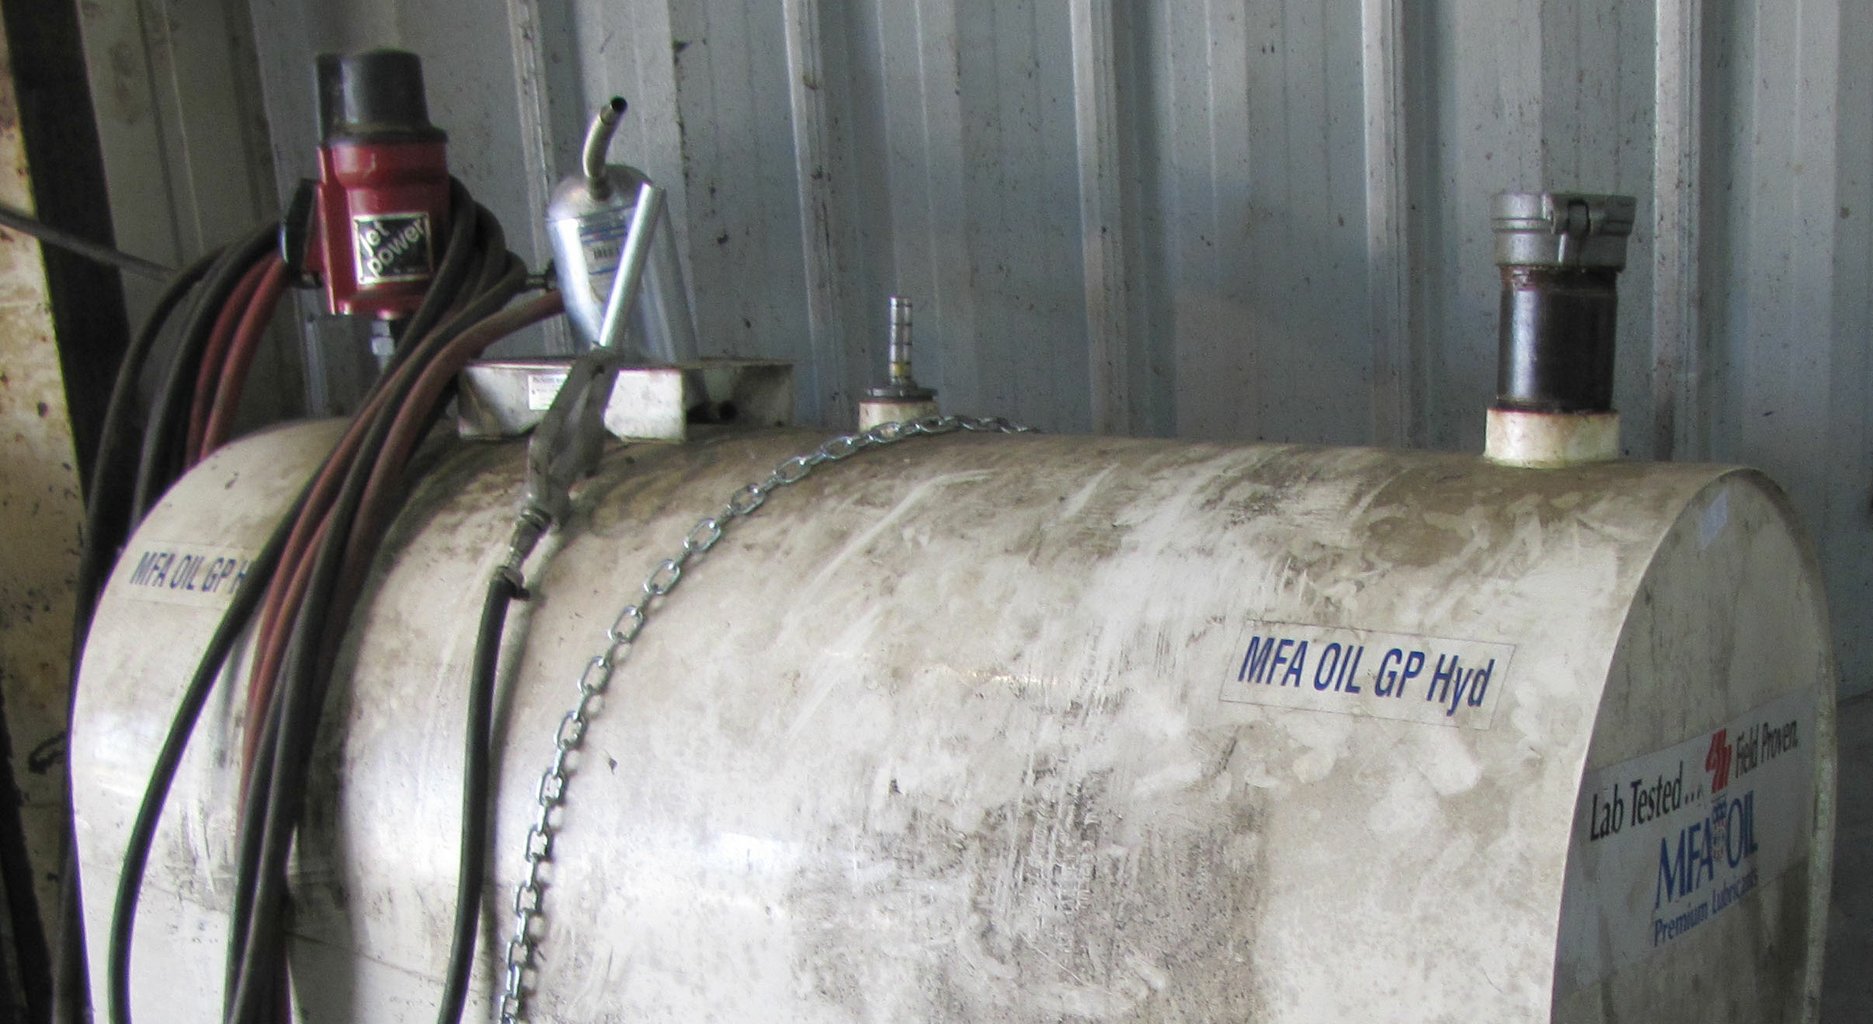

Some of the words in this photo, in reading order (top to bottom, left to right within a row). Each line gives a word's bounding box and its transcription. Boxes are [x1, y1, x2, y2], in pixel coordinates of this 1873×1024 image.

[367, 218, 424, 279] power
[129, 551, 176, 587] MFA
[169, 555, 205, 591] OIL
[201, 557, 237, 593] GP
[1237, 635, 1309, 687] MFA
[1313, 642, 1365, 694] OIL
[1374, 648, 1426, 698] GP
[1426, 653, 1496, 717] Hyd
[1590, 783, 1625, 842] Lab
[1735, 723, 1759, 778] Field
[1655, 816, 1714, 909] MFA
[1726, 790, 1758, 868] OIL
[1654, 901, 1709, 948] Premium
